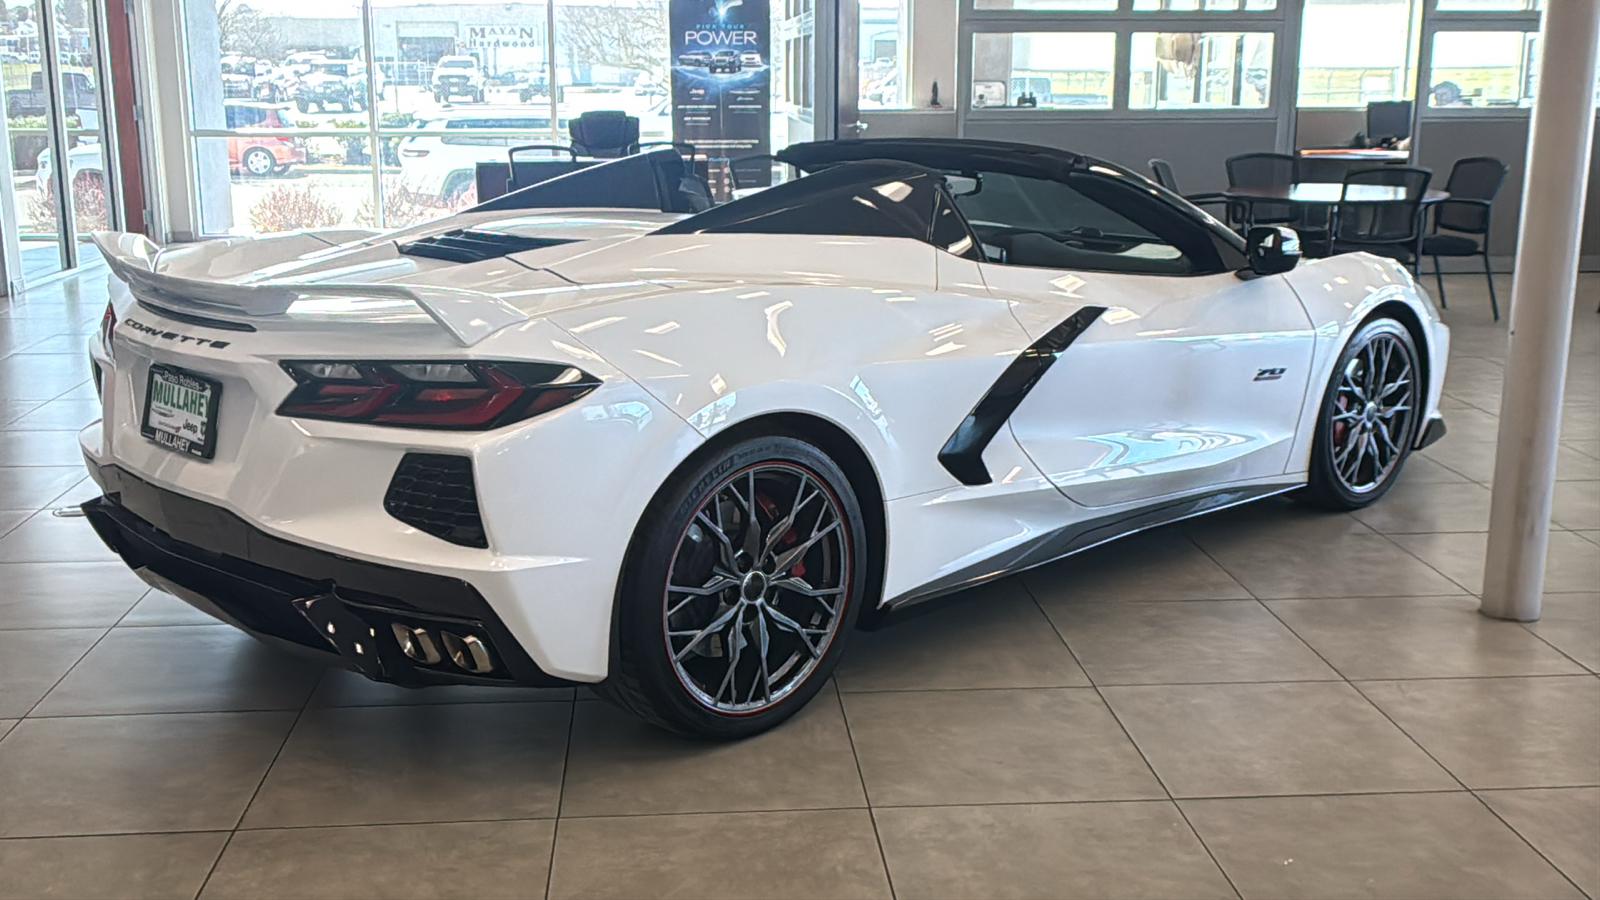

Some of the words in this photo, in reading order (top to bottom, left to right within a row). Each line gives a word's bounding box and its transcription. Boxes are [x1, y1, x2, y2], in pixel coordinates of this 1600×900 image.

[469, 27, 533, 38] MAYAN
[685, 30, 757, 45] POWER
[469, 38, 535, 47] Hardwood
[124, 318, 231, 349] CORVETTE
[164, 370, 179, 384] Paso
[179, 375, 200, 391] Robles
[153, 380, 210, 418] MULLAHEY
[183, 419, 198, 434] Jeep
[155, 429, 190, 452] MULLAHEY
